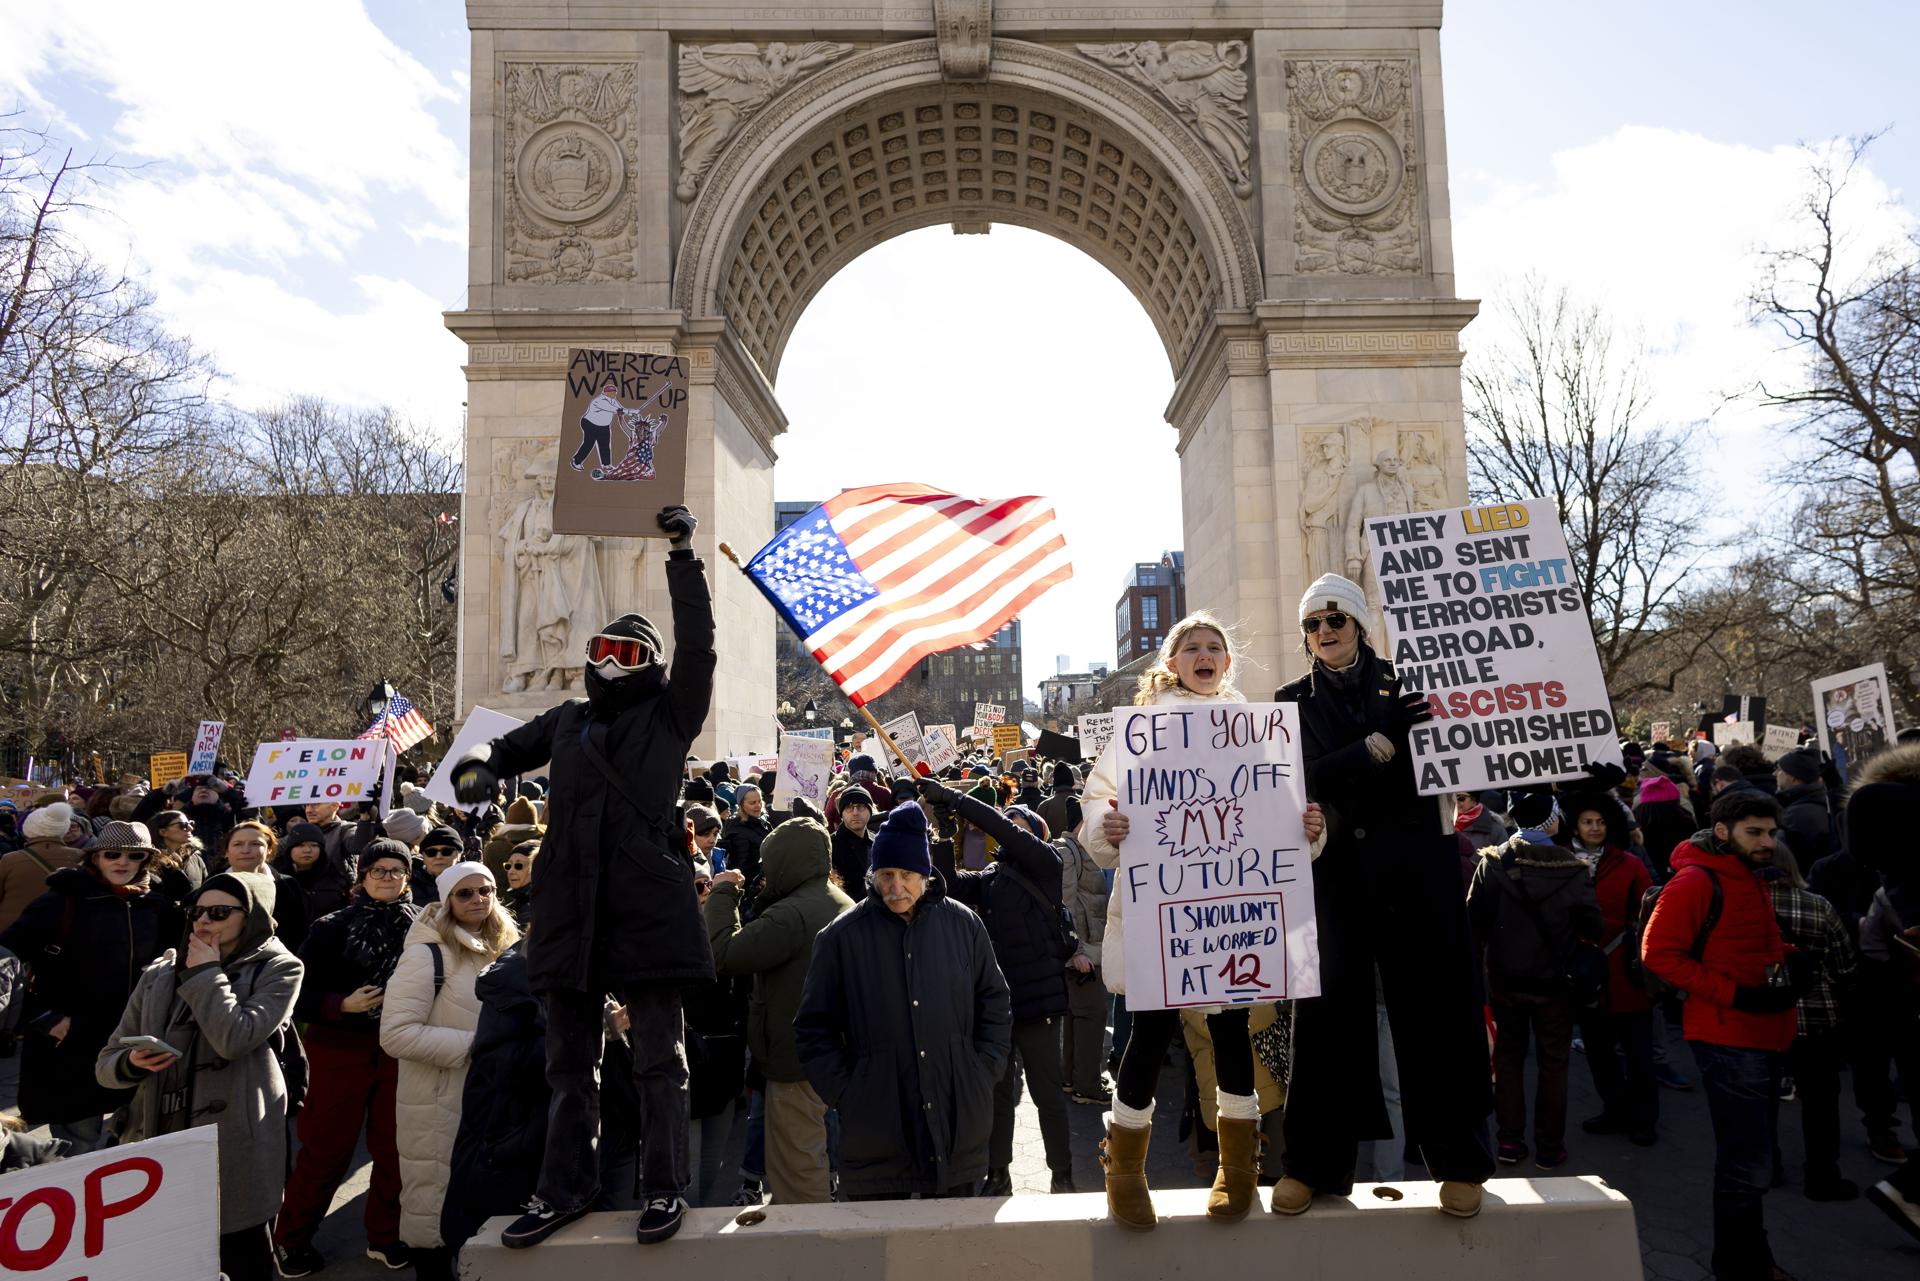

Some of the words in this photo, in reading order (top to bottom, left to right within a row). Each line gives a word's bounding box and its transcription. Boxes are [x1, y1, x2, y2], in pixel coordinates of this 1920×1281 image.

[743, 9, 814, 19] ERECTED
[818, 9, 835, 20] BY
[845, 9, 872, 20] THE
[879, 9, 930, 20] PEOPLE
[995, 9, 1013, 20] OF
[1020, 9, 1045, 20] THE
[1051, 8, 1084, 19] CITY
[1090, 8, 1106, 19] OF
[1112, 8, 1144, 19] NEW
[1153, 8, 1189, 19] YORK
[568, 372, 648, 400] WAKE
[659, 388, 687, 409] UP
[1370, 515, 1447, 547] THEY
[1461, 503, 1530, 535] LIED
[1379, 545, 1444, 577] AND
[1455, 534, 1531, 566] SENT
[1383, 577, 1428, 605] ME
[1433, 571, 1477, 598] TO
[1479, 558, 1567, 593] FIGHT
[1395, 622, 1545, 665] ABROAD,
[1399, 656, 1499, 693] WHILE
[988, 714, 1004, 722] BODY
[1422, 680, 1568, 721] ASCISTS
[198, 741, 218, 752] RICH
[202, 724, 222, 736] TAX
[974, 727, 993, 736] DECIS
[1084, 728, 1098, 736] WE
[1125, 712, 1194, 756] GET
[1210, 708, 1291, 750] YOUR
[1412, 709, 1613, 756] FLOURISHED
[273, 769, 308, 780] AND
[318, 767, 347, 777] THE
[932, 746, 956, 768] RANNY
[1419, 758, 1461, 791] AT
[1483, 744, 1589, 782] HOME!
[270, 782, 363, 801] FELON
[1127, 767, 1216, 805] HANDS
[1231, 764, 1291, 799] OFF
[1180, 804, 1231, 846] MY
[1129, 848, 1300, 903] FUTURE
[1169, 906, 1177, 934] I
[1183, 901, 1279, 932] SHOULDN'T
[1171, 938, 1197, 958] BE
[1203, 926, 1277, 955] WORRIED
[1182, 964, 1213, 996] AT
[1218, 953, 1271, 989] 12
[0, 1157, 163, 1271] OP
